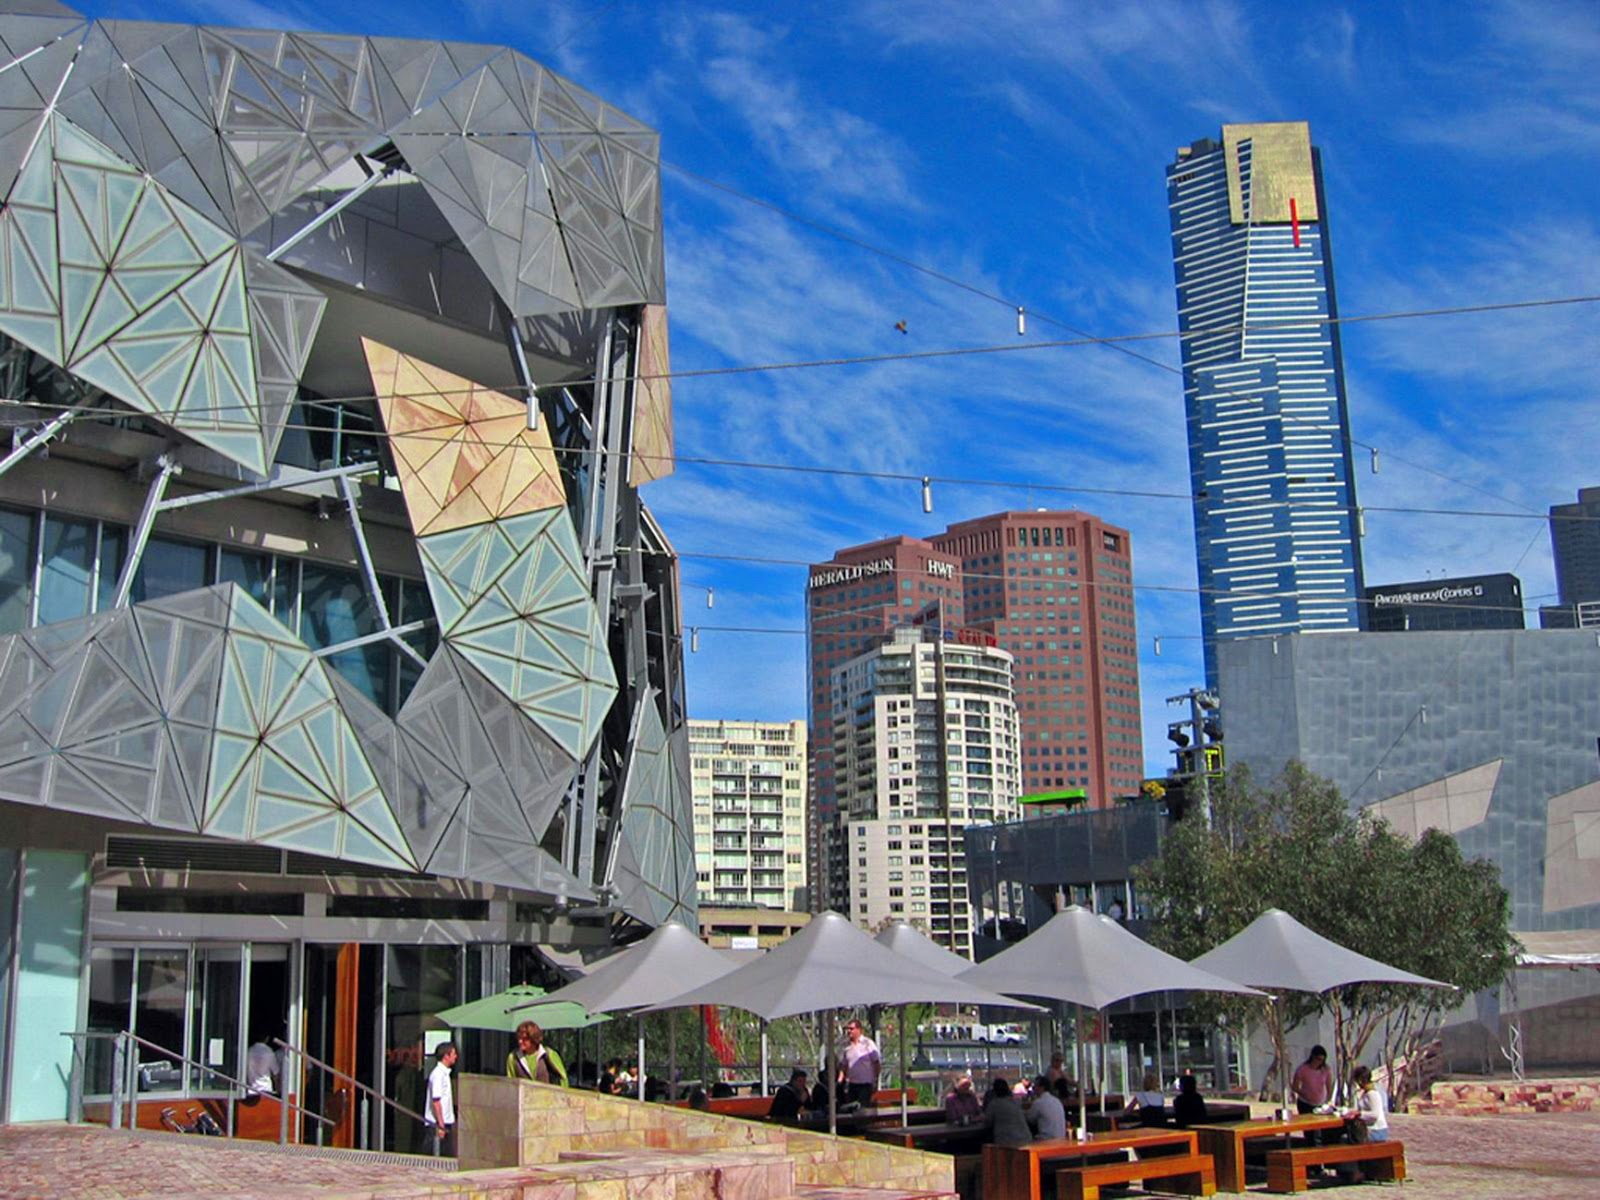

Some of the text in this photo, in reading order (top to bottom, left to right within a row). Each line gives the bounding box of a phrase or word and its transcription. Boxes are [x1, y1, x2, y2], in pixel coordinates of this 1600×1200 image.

[810, 558, 893, 587] HERALD SUN
[928, 559, 954, 578] HWT
